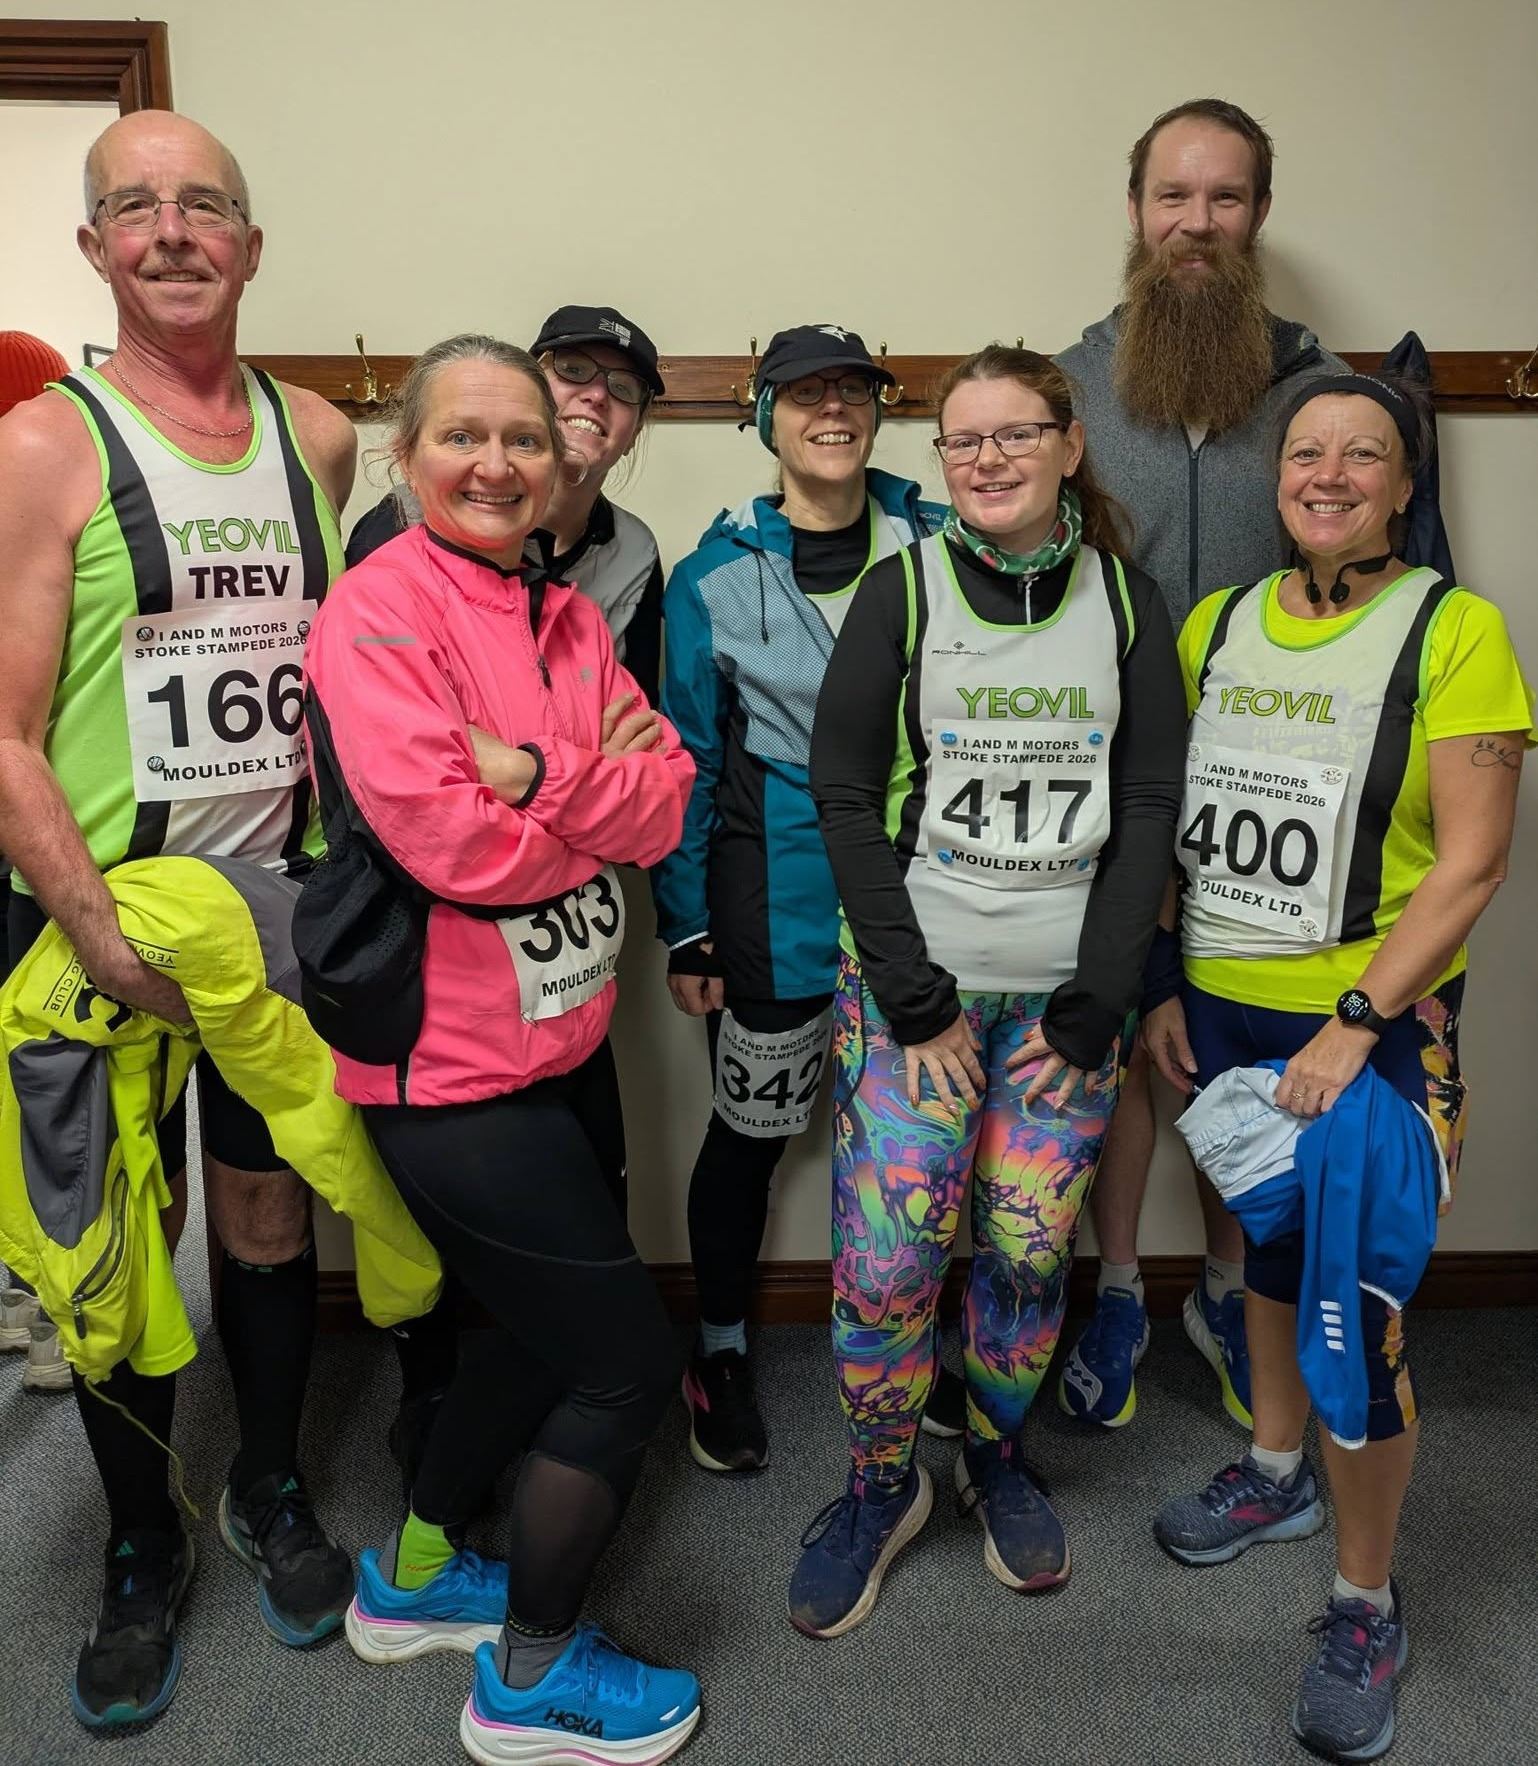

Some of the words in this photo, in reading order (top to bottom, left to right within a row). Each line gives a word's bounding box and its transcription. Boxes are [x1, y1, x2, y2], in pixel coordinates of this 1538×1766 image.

[162, 518, 300, 554] YEOVIL
[188, 565, 290, 600] TREV
[135, 646, 191, 658] STOKE
[196, 639, 274, 655] STAMPEDE
[279, 635, 307, 647] 2026
[159, 631, 164, 641] I
[170, 629, 204, 640] AND
[211, 628, 224, 638] M
[230, 622, 288, 636] MOTORS
[148, 663, 304, 748] 166
[957, 687, 1094, 718] YEOVIL
[1219, 686, 1336, 724] YEOVIL
[943, 751, 988, 762] STOKE
[993, 754, 1063, 764] STAMPEDE
[1068, 754, 1096, 764] 2026
[963, 739, 967, 747] I
[972, 739, 1002, 749] AND
[1007, 741, 1017, 750] M
[1023, 741, 1079, 750] MOTORS
[163, 757, 268, 781] MOULDEX
[275, 754, 300, 769] LTD
[1204, 763, 1208, 772] I
[1210, 764, 1235, 776] AND
[1239, 769, 1250, 779] M
[1253, 771, 1308, 789] MOTORS
[1189, 775, 1223, 788] STOKE
[1227, 781, 1292, 801] STAMPEDE
[1296, 793, 1326, 807] 2026
[942, 778, 1092, 844] 417
[951, 849, 1041, 871] MOULDEX
[1181, 803, 1319, 887] 400
[1200, 880, 1265, 907] OULDEX
[1269, 897, 1303, 917] LTD
[520, 874, 619, 963] 303
[130, 944, 174, 965] YEOV
[51, 978, 72, 1011] CLUB
[542, 964, 601, 997] MOULDEX
[740, 1039, 762, 1051] AND
[755, 1043, 810, 1060] STAMPEDE
[722, 1051, 823, 1109] 342
[724, 1103, 791, 1127] MOULDEX
[544, 1707, 604, 1738] HOKA
